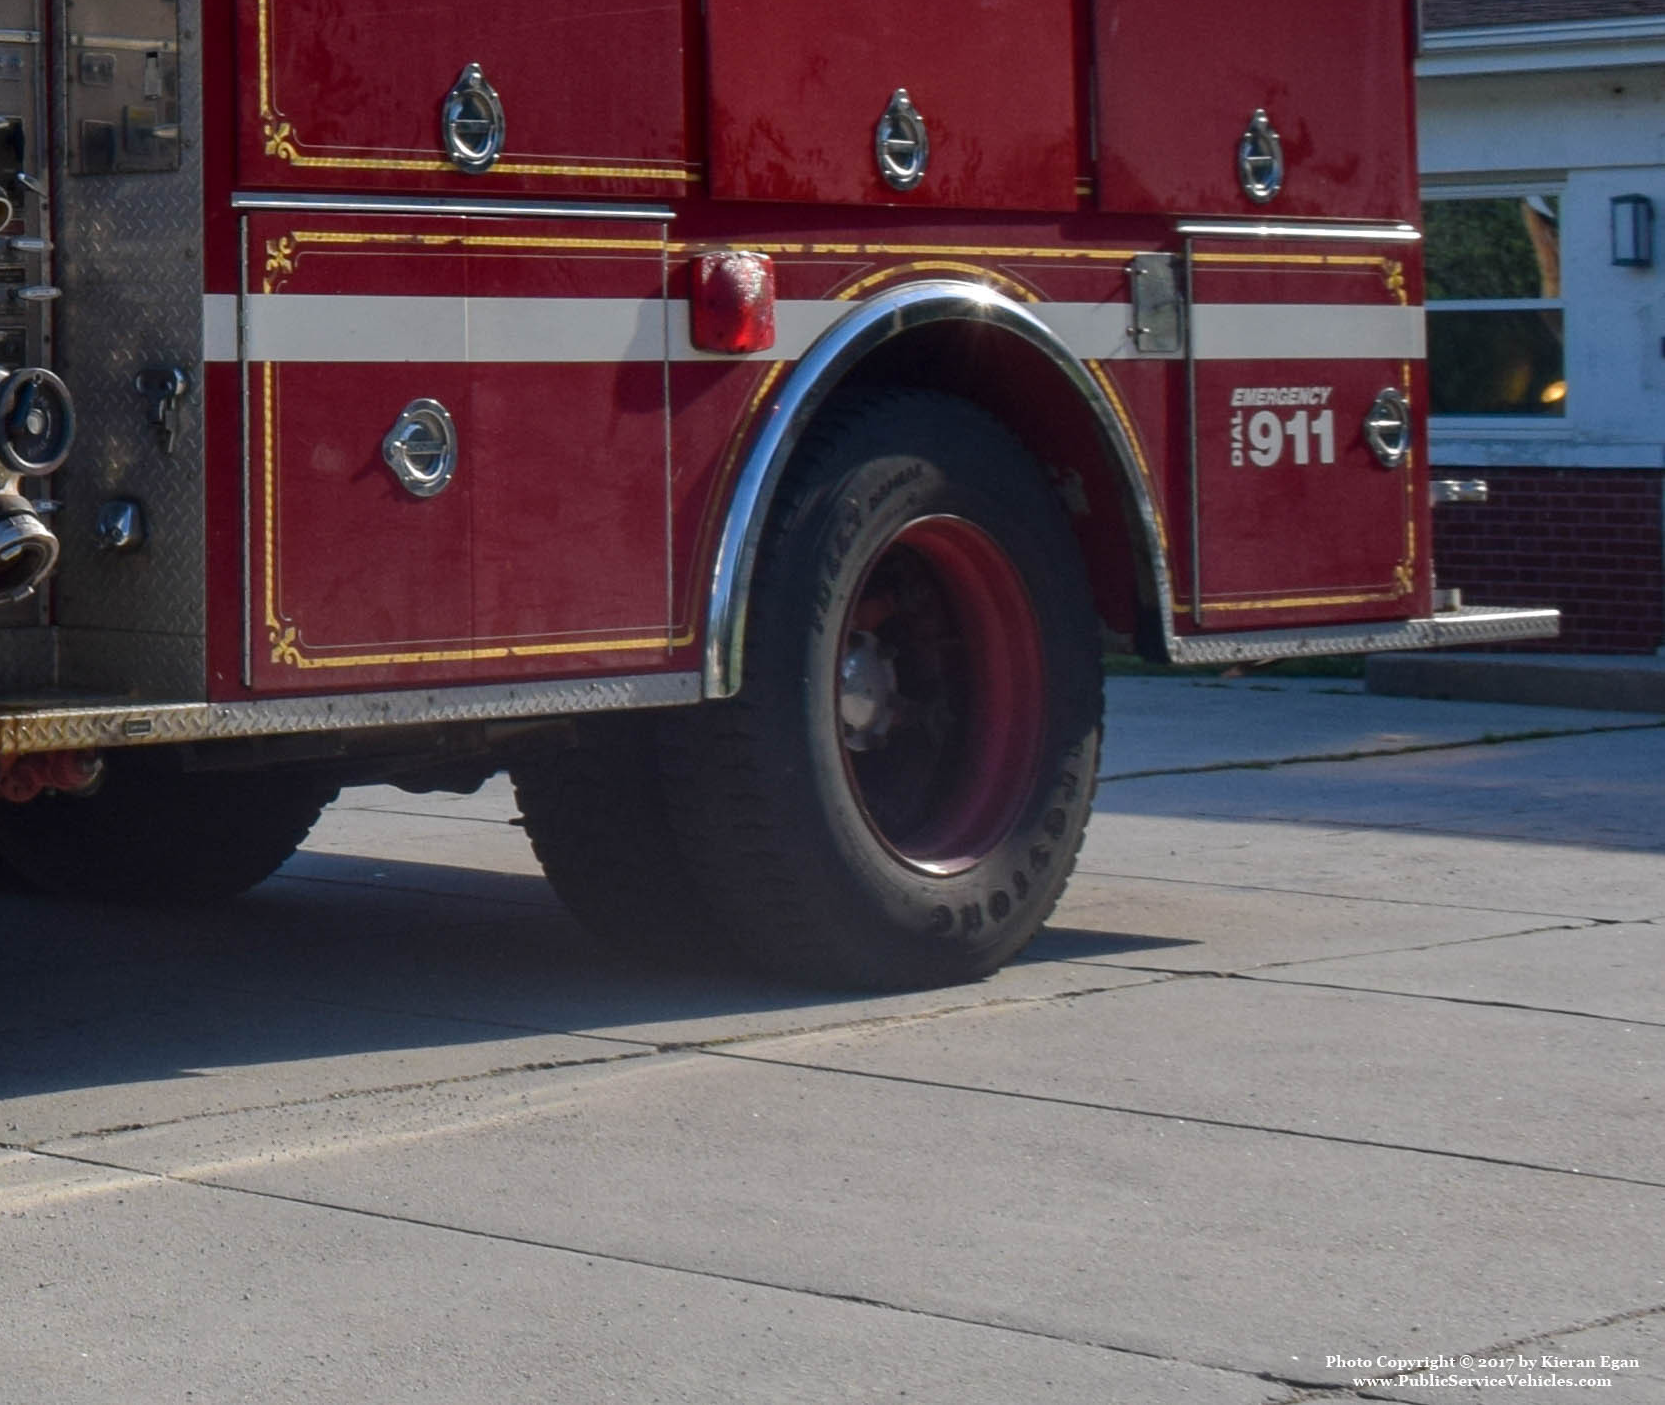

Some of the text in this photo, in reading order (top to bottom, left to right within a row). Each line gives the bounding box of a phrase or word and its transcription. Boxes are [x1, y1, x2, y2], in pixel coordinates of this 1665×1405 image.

[1231, 386, 1333, 406] EMERGENCY
[1231, 410, 1244, 466] DIAL
[1248, 409, 1335, 467] 911
